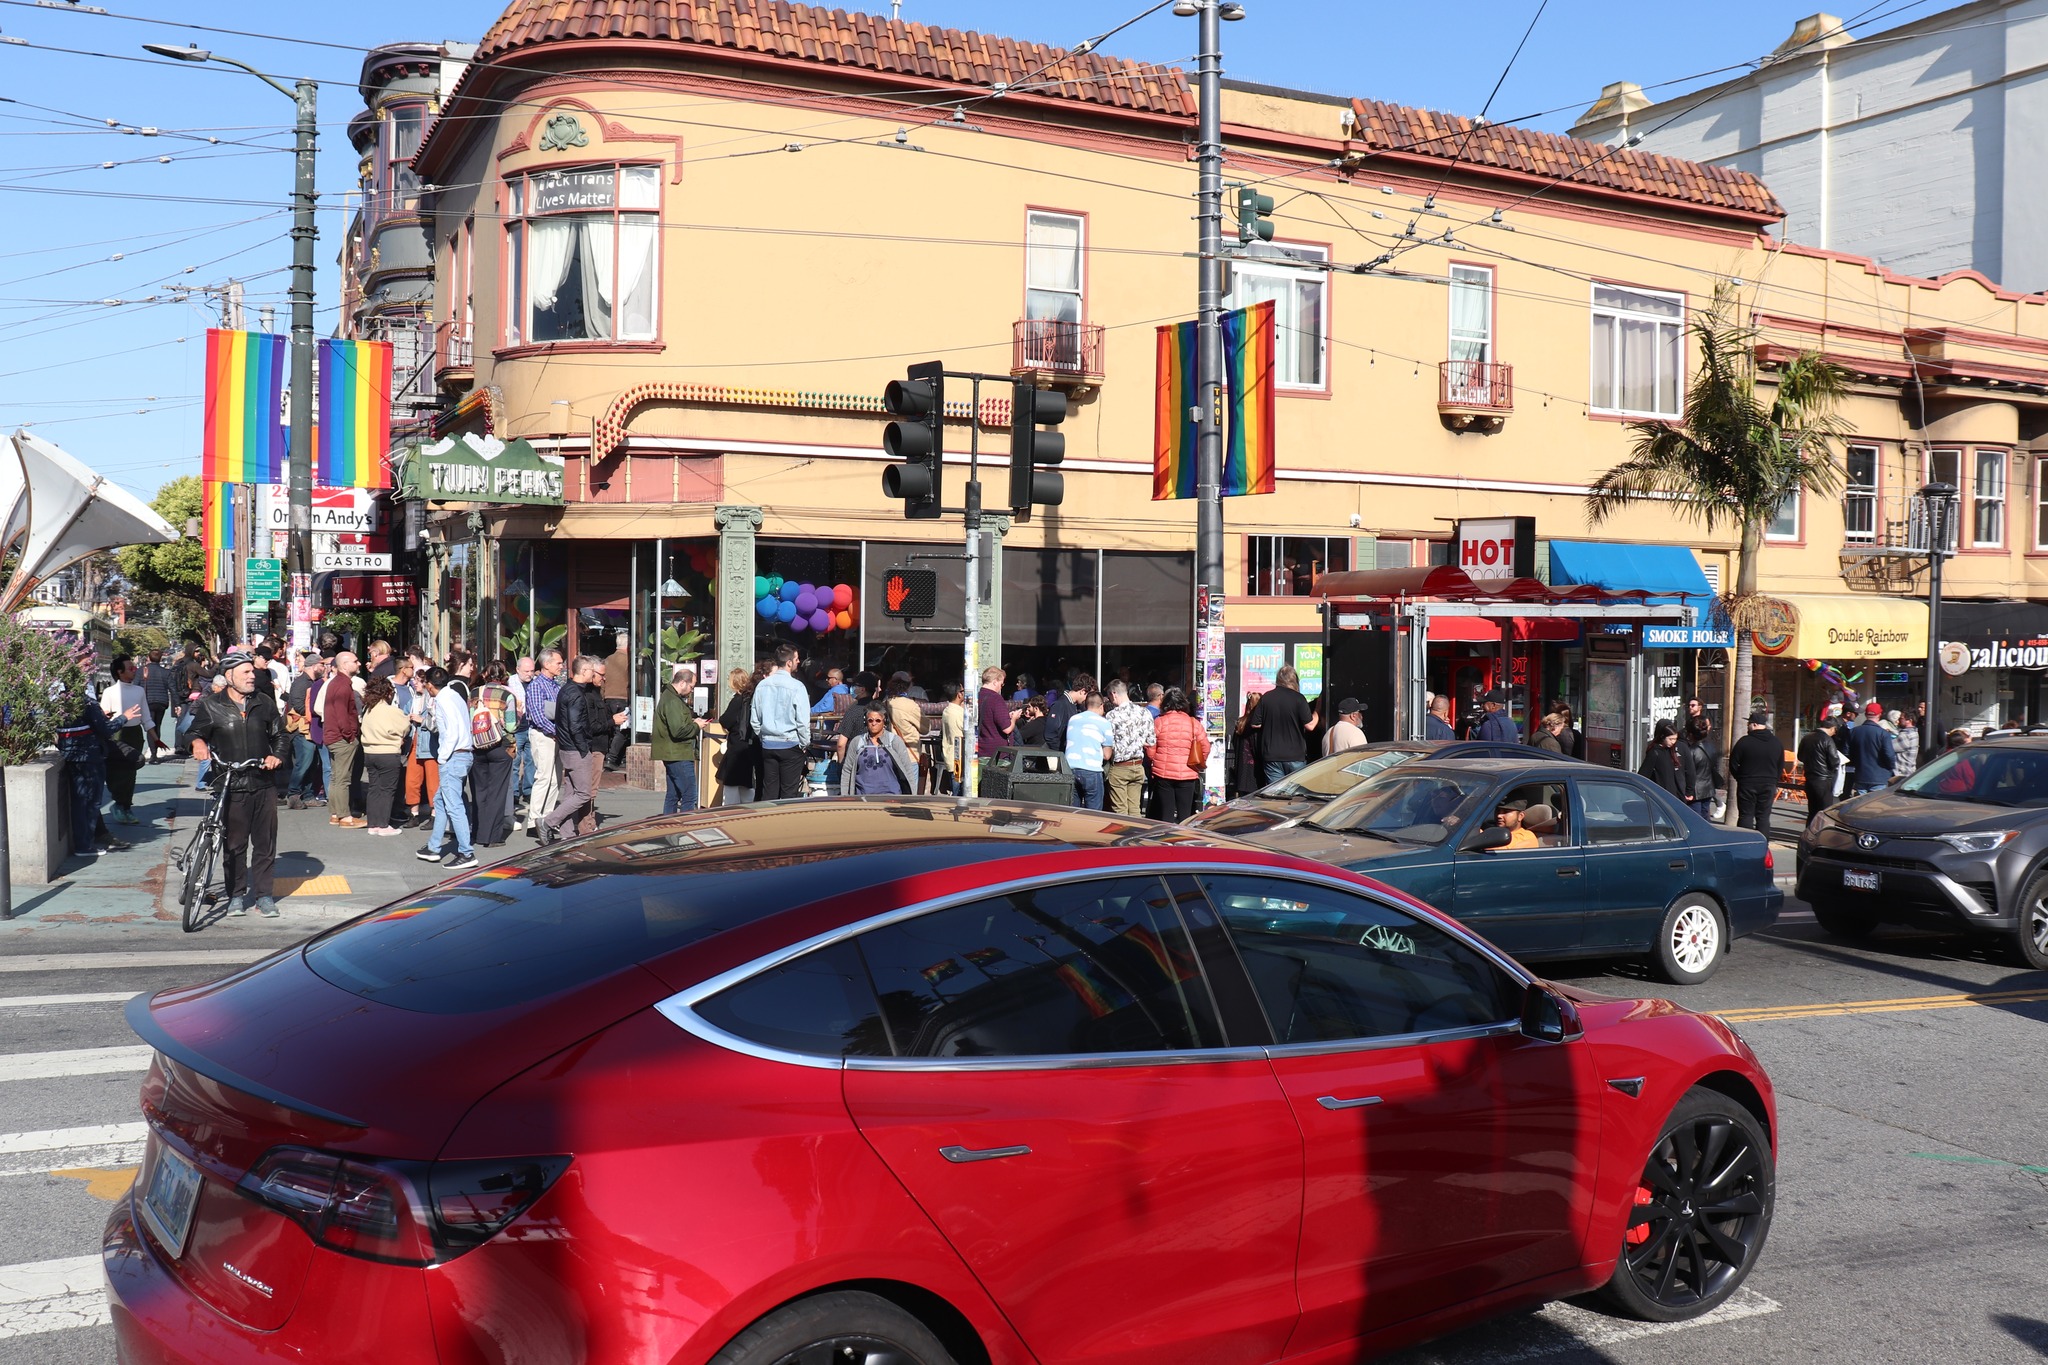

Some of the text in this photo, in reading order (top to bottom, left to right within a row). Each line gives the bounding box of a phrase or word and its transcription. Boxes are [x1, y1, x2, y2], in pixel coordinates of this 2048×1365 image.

[536, 192, 612, 209] Lives Matter
[494, 468, 562, 497] PEAKS
[325, 509, 373, 529] Andy's
[1462, 539, 1514, 566] HOT
[324, 556, 383, 568] CASTRO
[1648, 629, 1688, 643] SMOKE
[1692, 630, 1729, 644] HOUSE
[1828, 627, 1910, 647] Double Rainbow
[1300, 651, 1316, 659] YOU
[1656, 666, 1681, 677] WATER
[1660, 677, 1677, 688] PIPE
[1652, 696, 1681, 709] SMOKE
[1654, 708, 1678, 721] SHOP
